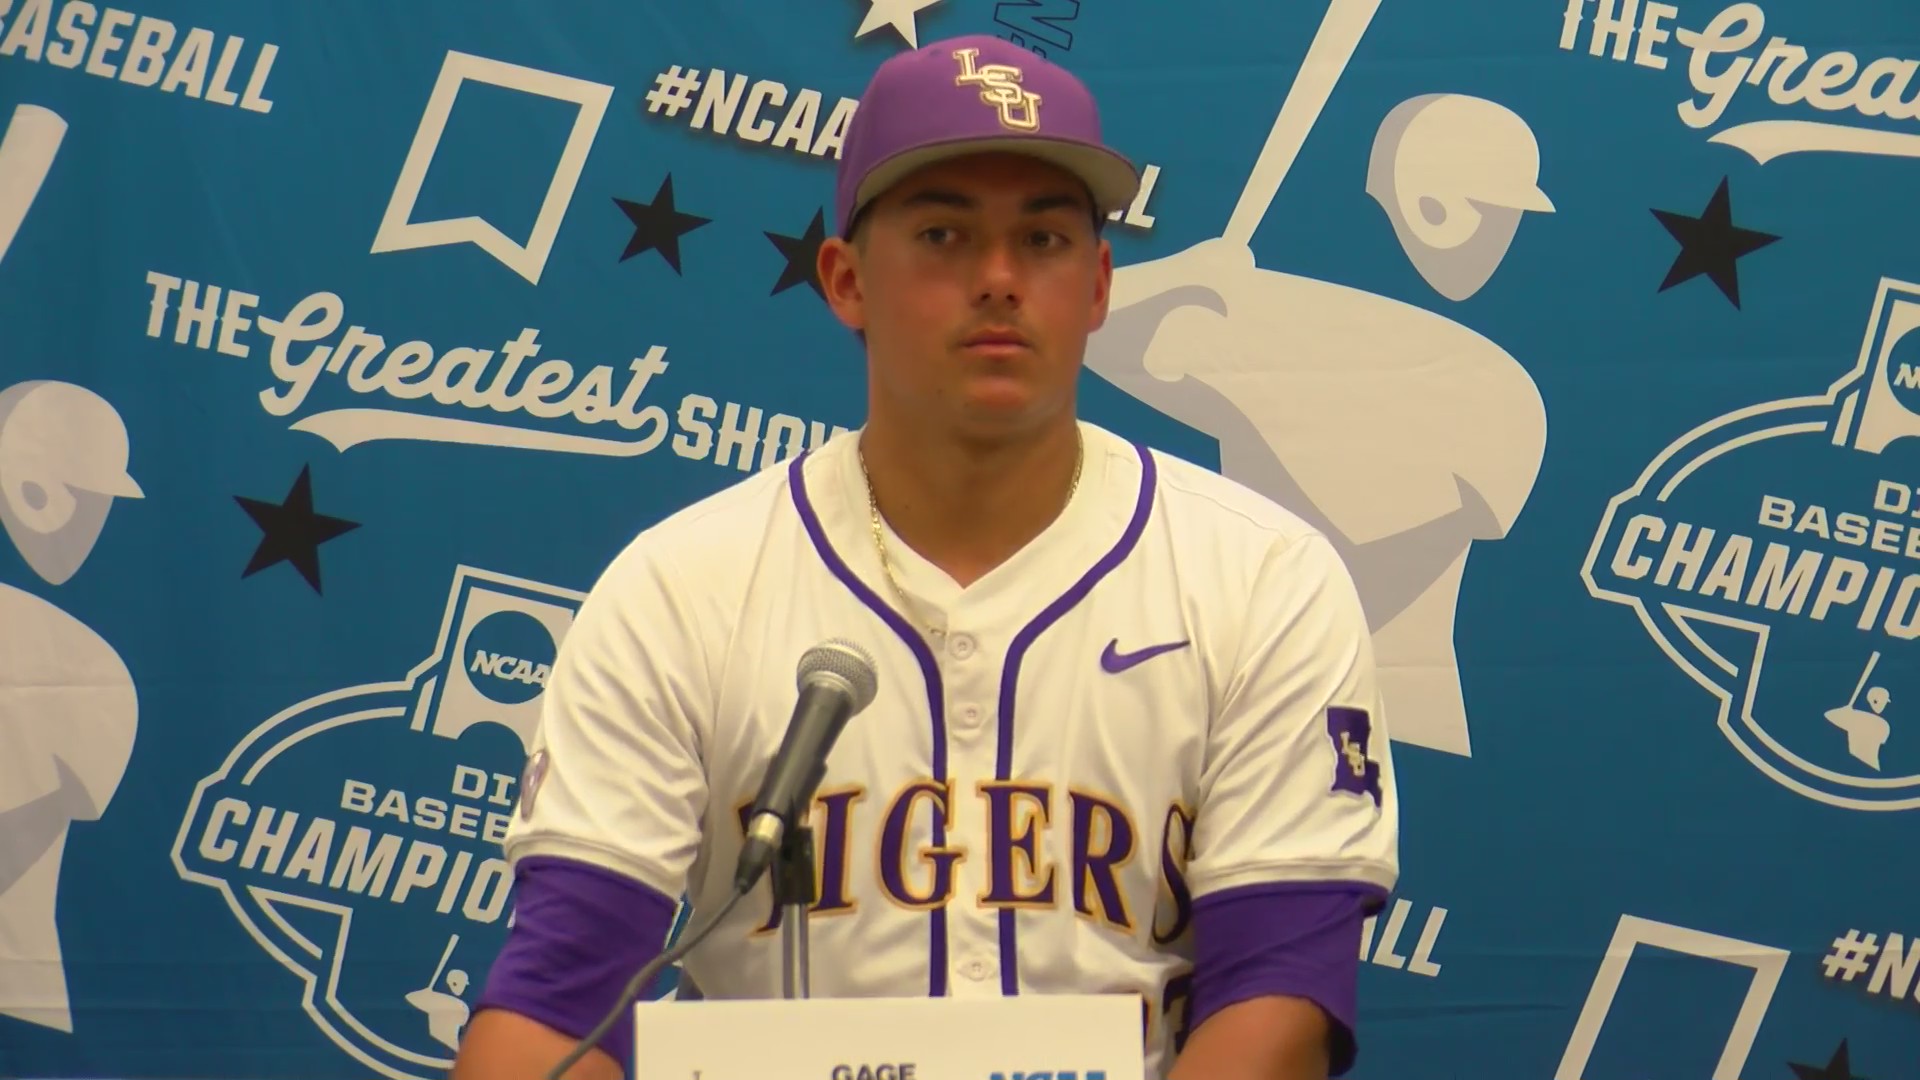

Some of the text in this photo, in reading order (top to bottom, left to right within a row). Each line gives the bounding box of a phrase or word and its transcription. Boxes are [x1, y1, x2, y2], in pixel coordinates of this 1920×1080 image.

[0, 0, 279, 113] ASEBALL
[953, 48, 1042, 133] LSU
[1559, 0, 1920, 128] THE Grea
[146, 271, 260, 358] THE
[257, 291, 668, 432] Greatest
[470, 650, 552, 689] NCAA
[452, 764, 516, 806] DI
[199, 797, 517, 929] CHAMPIO
[831, 1063, 917, 1080] GAGE
